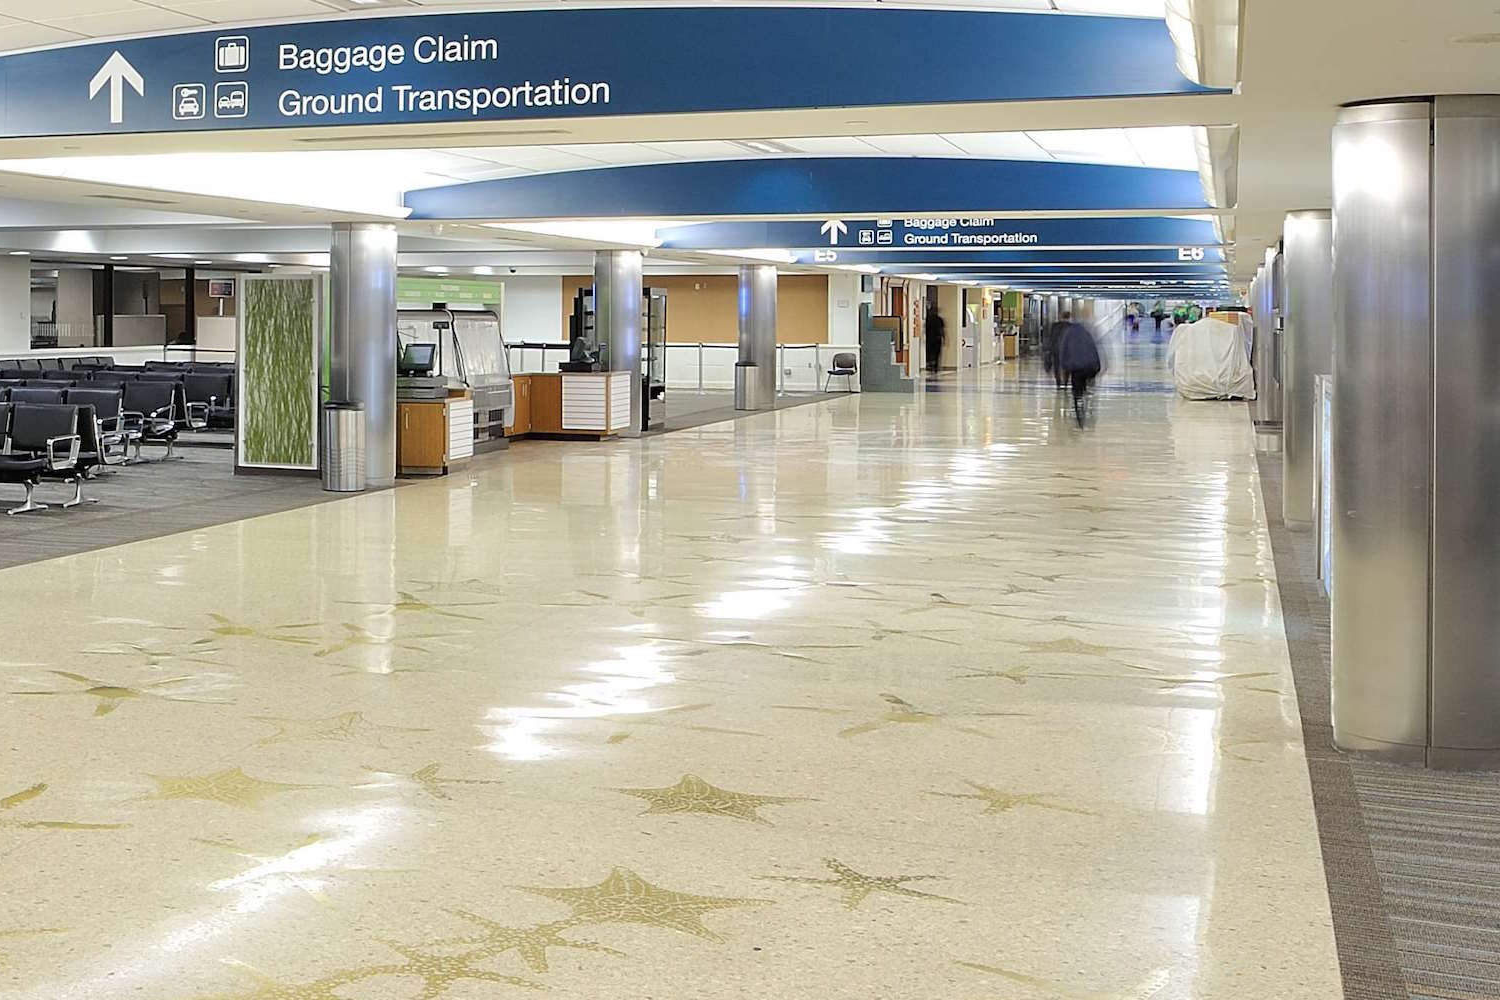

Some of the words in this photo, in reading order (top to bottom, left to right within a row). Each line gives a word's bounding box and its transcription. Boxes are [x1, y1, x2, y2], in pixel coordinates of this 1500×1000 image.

[278, 42, 405, 74] Baggage
[413, 35, 498, 62] Claim
[278, 86, 384, 116] Ground
[392, 79, 611, 115] Transportation
[904, 219, 956, 229] Baggage
[960, 217, 995, 226] Claim
[904, 233, 948, 245] Ground
[951, 230, 1038, 245] Transportation
